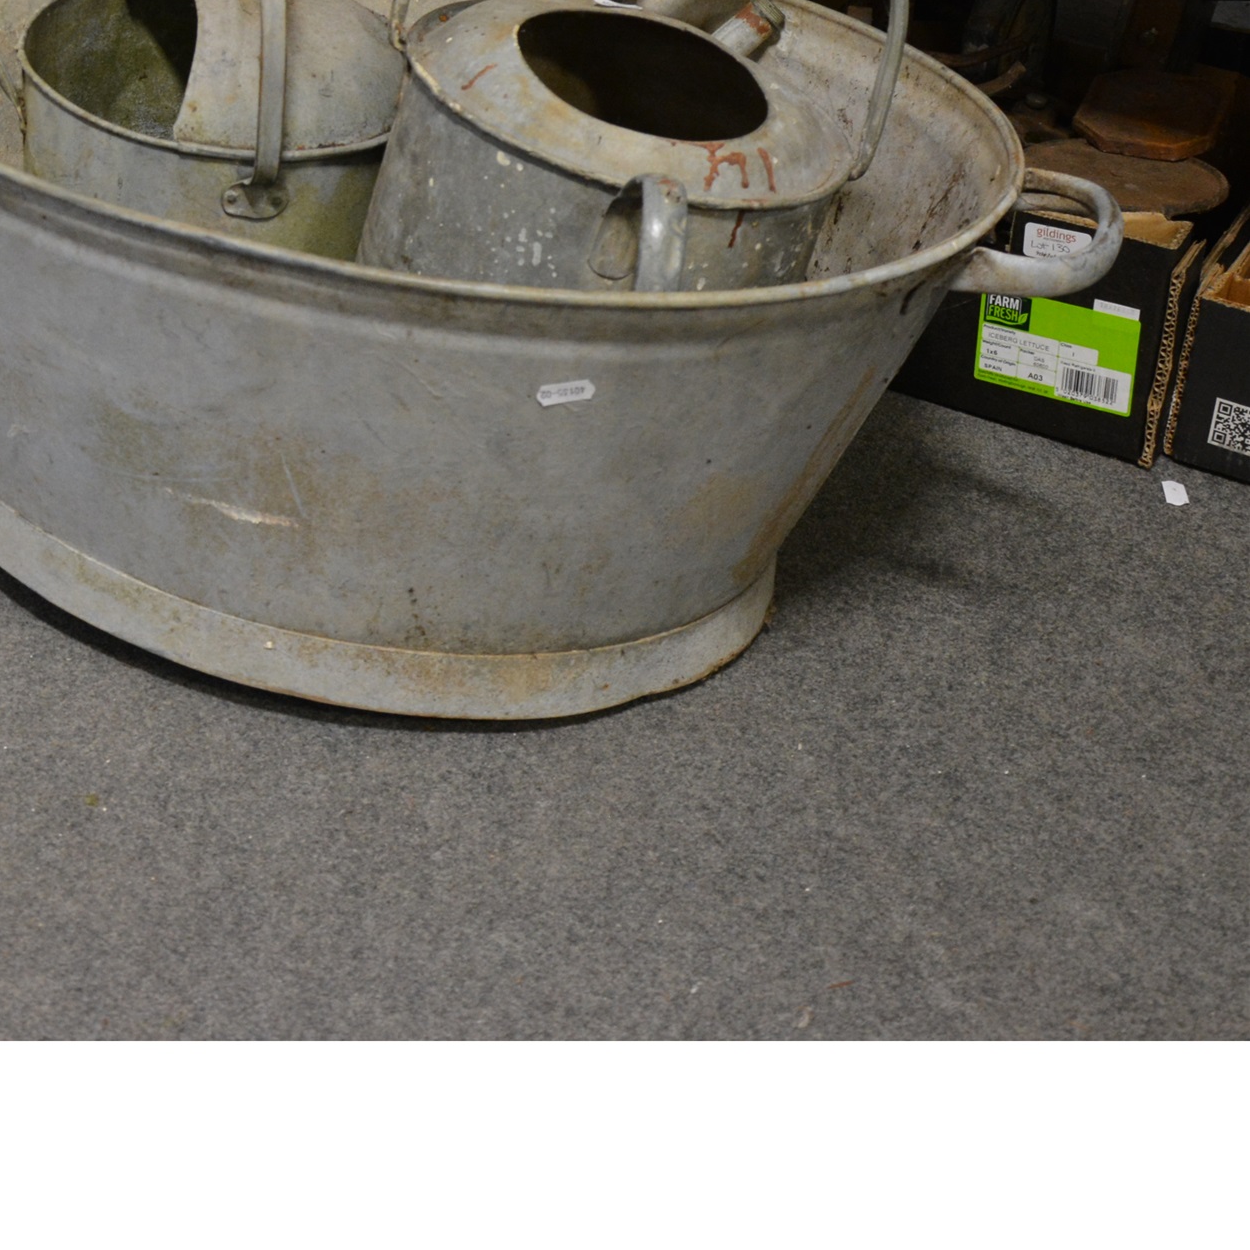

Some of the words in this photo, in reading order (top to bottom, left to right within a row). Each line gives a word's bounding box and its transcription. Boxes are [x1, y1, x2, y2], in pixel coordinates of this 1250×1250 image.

[1037, 227, 1077, 243] gildings
[1031, 240, 1049, 249] Lot
[1052, 244, 1070, 253] 130
[989, 294, 1020, 310] FARM
[988, 305, 1019, 322] FRESH
[988, 333, 1018, 344] ICEBERG
[1019, 340, 1050, 352] LETTUCE
[984, 363, 1002, 371] SPAIN
[1028, 373, 1043, 382] A03
